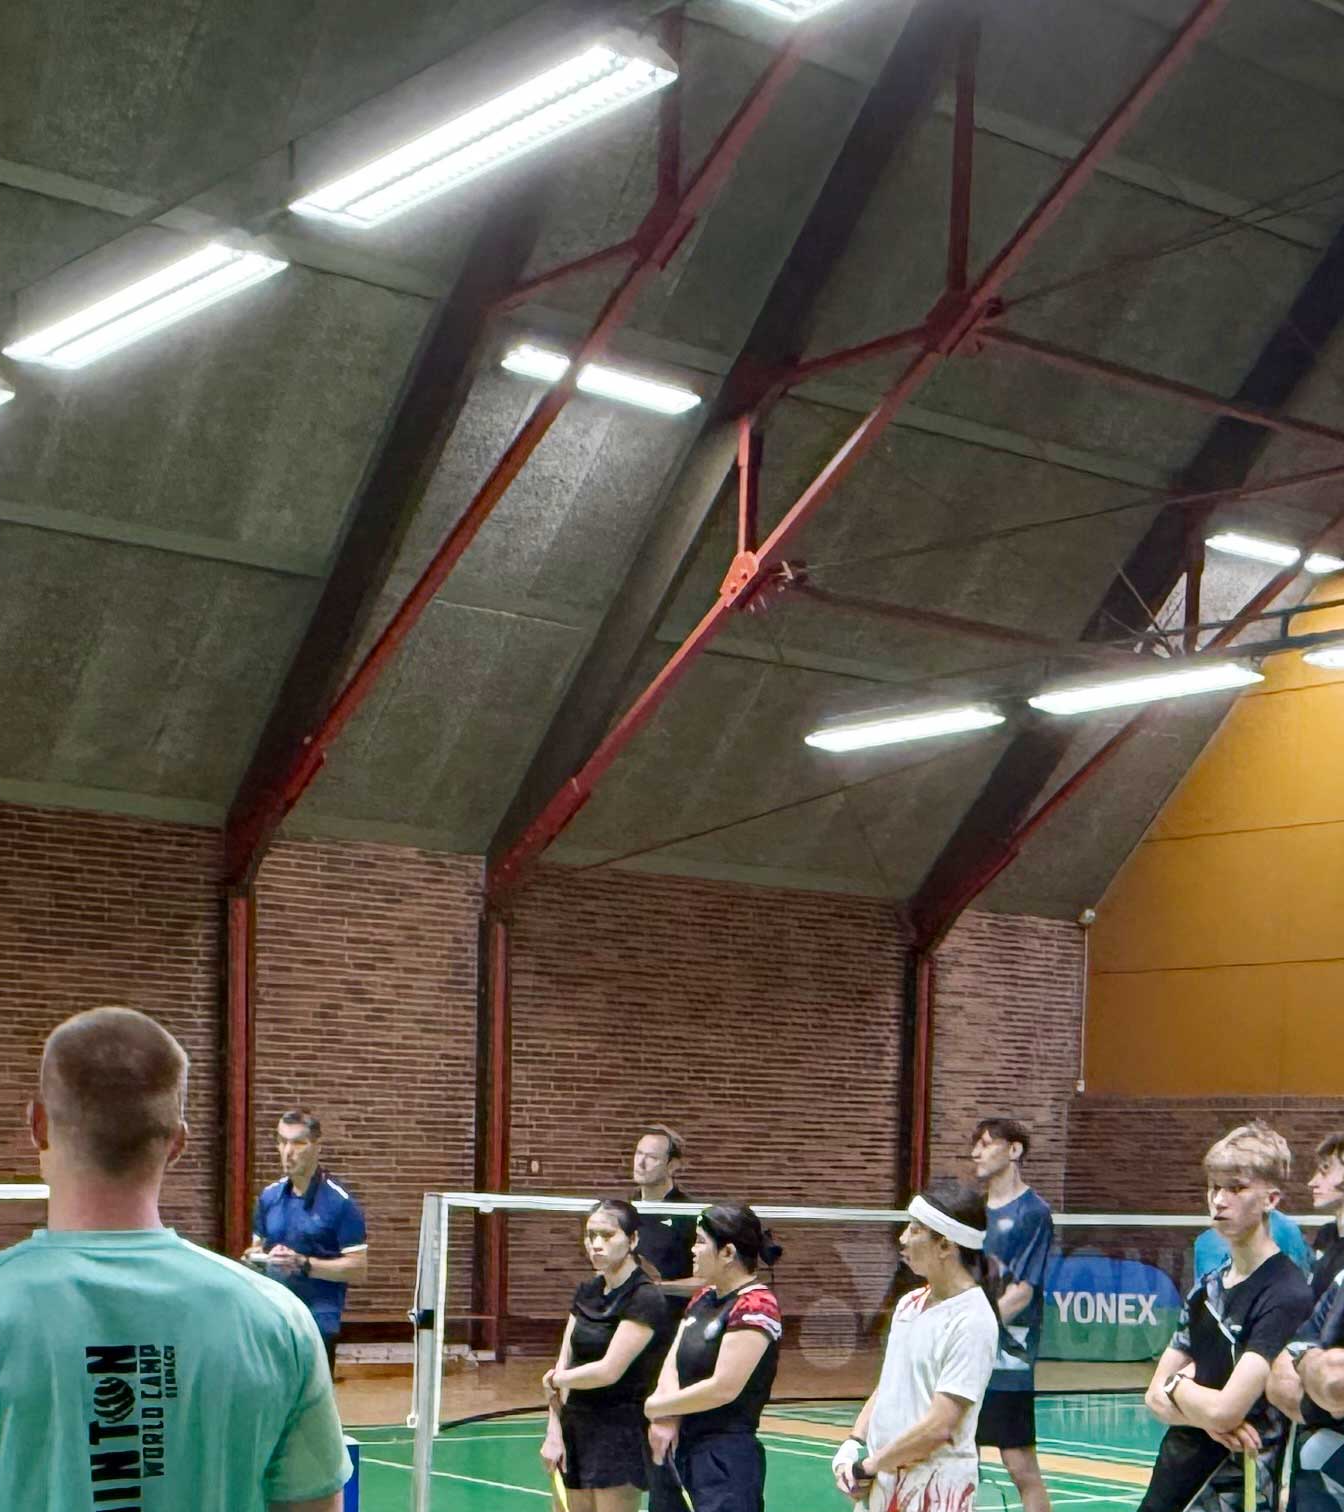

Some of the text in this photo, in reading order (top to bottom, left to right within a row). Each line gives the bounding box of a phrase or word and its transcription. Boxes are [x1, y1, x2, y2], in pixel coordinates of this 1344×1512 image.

[1052, 1290, 1159, 1327] YONEX
[139, 1344, 166, 1478] WORLD CAMP
